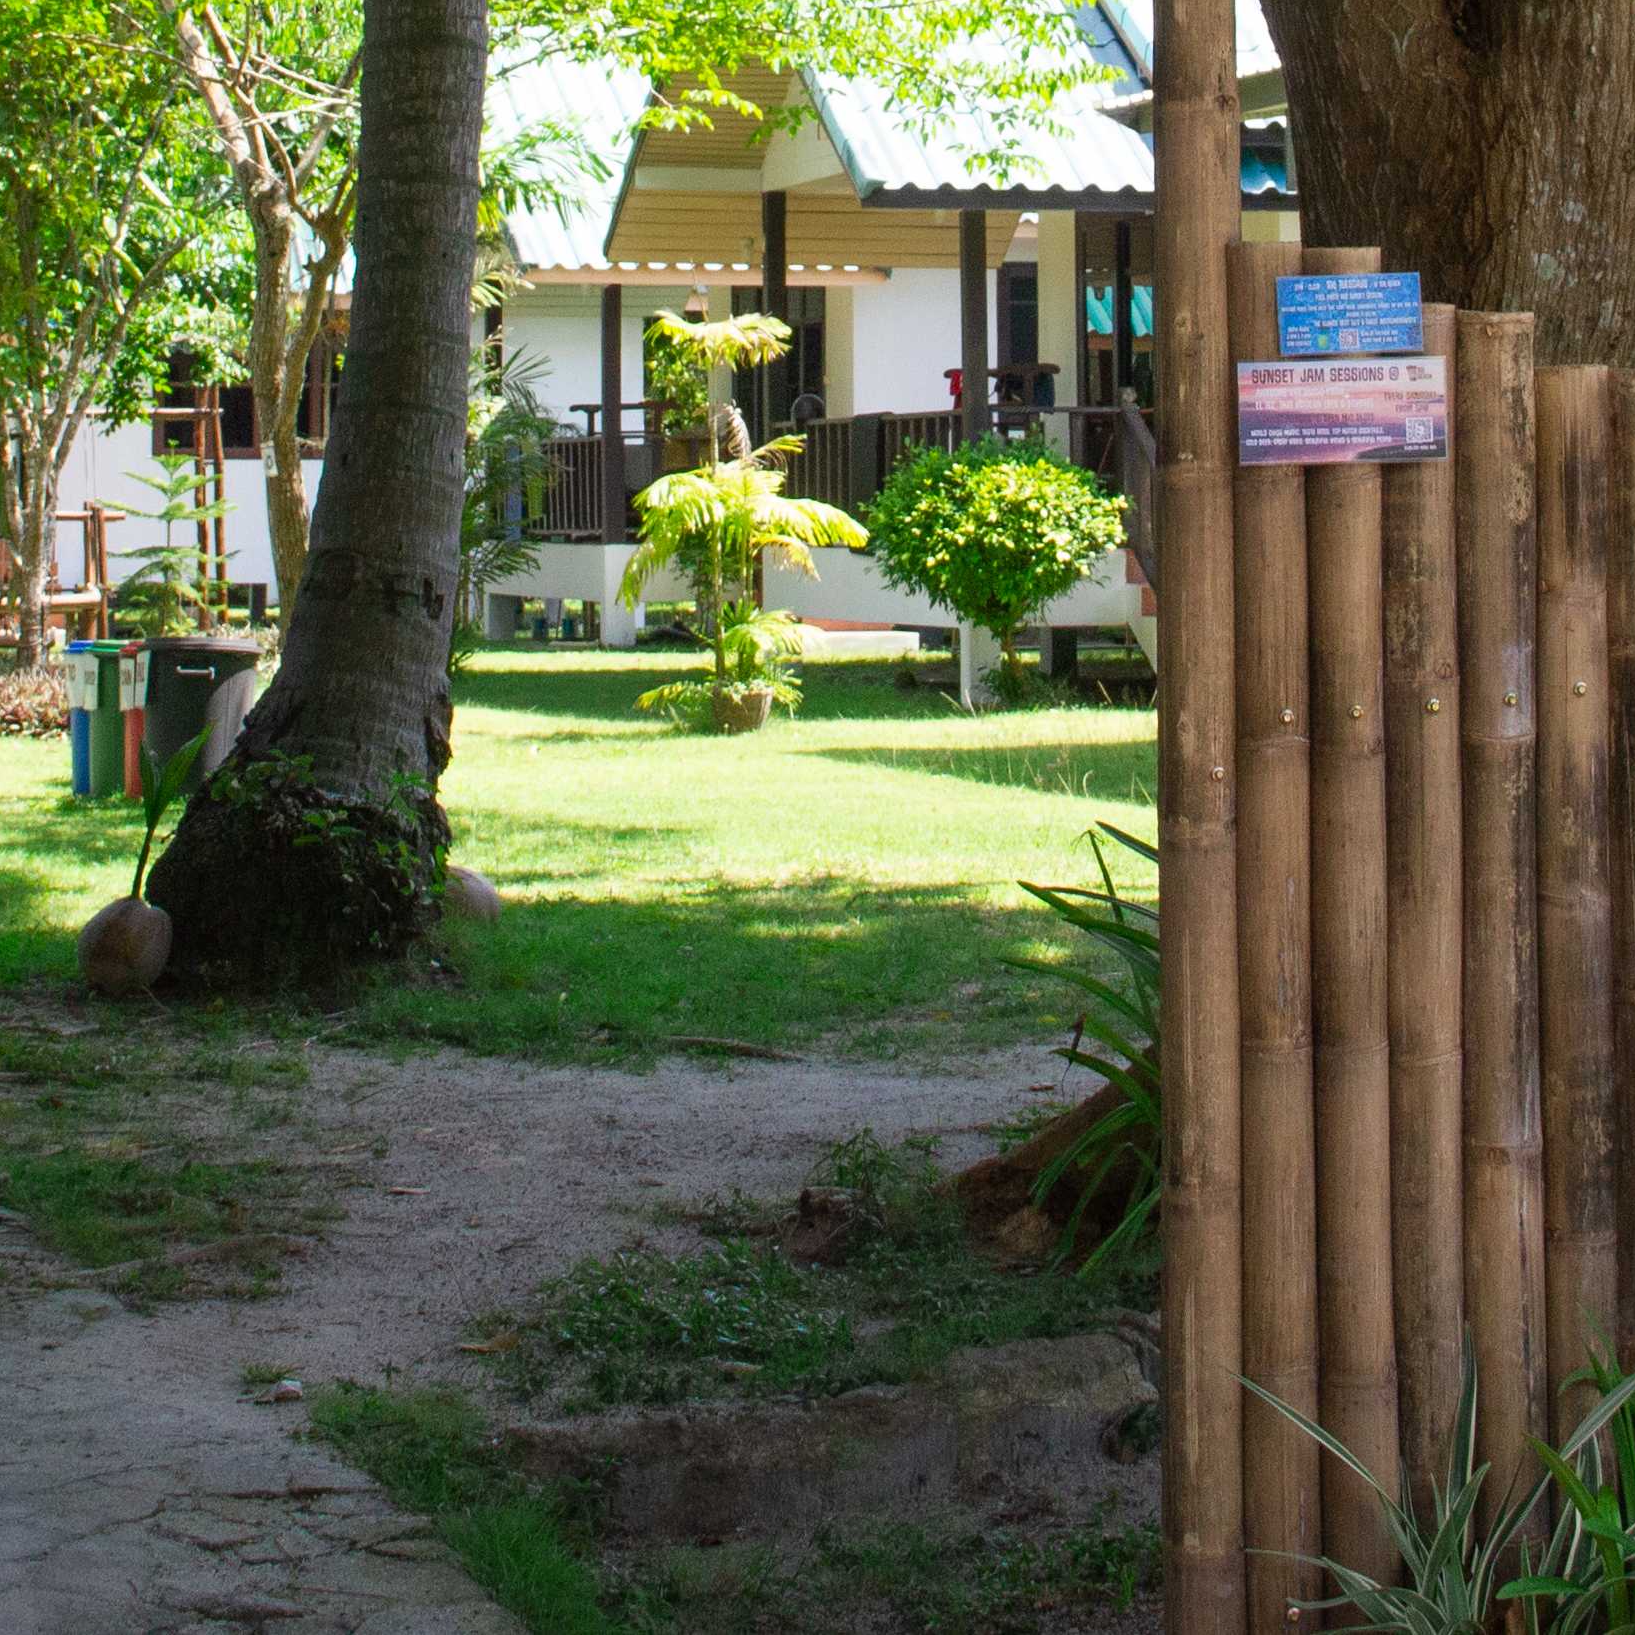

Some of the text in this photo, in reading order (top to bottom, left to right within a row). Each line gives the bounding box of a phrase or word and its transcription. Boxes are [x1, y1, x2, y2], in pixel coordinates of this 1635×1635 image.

[1252, 369, 1294, 384] SUNSET
[1300, 368, 1325, 383] JAM
[1329, 366, 1384, 382] SESSIONS
